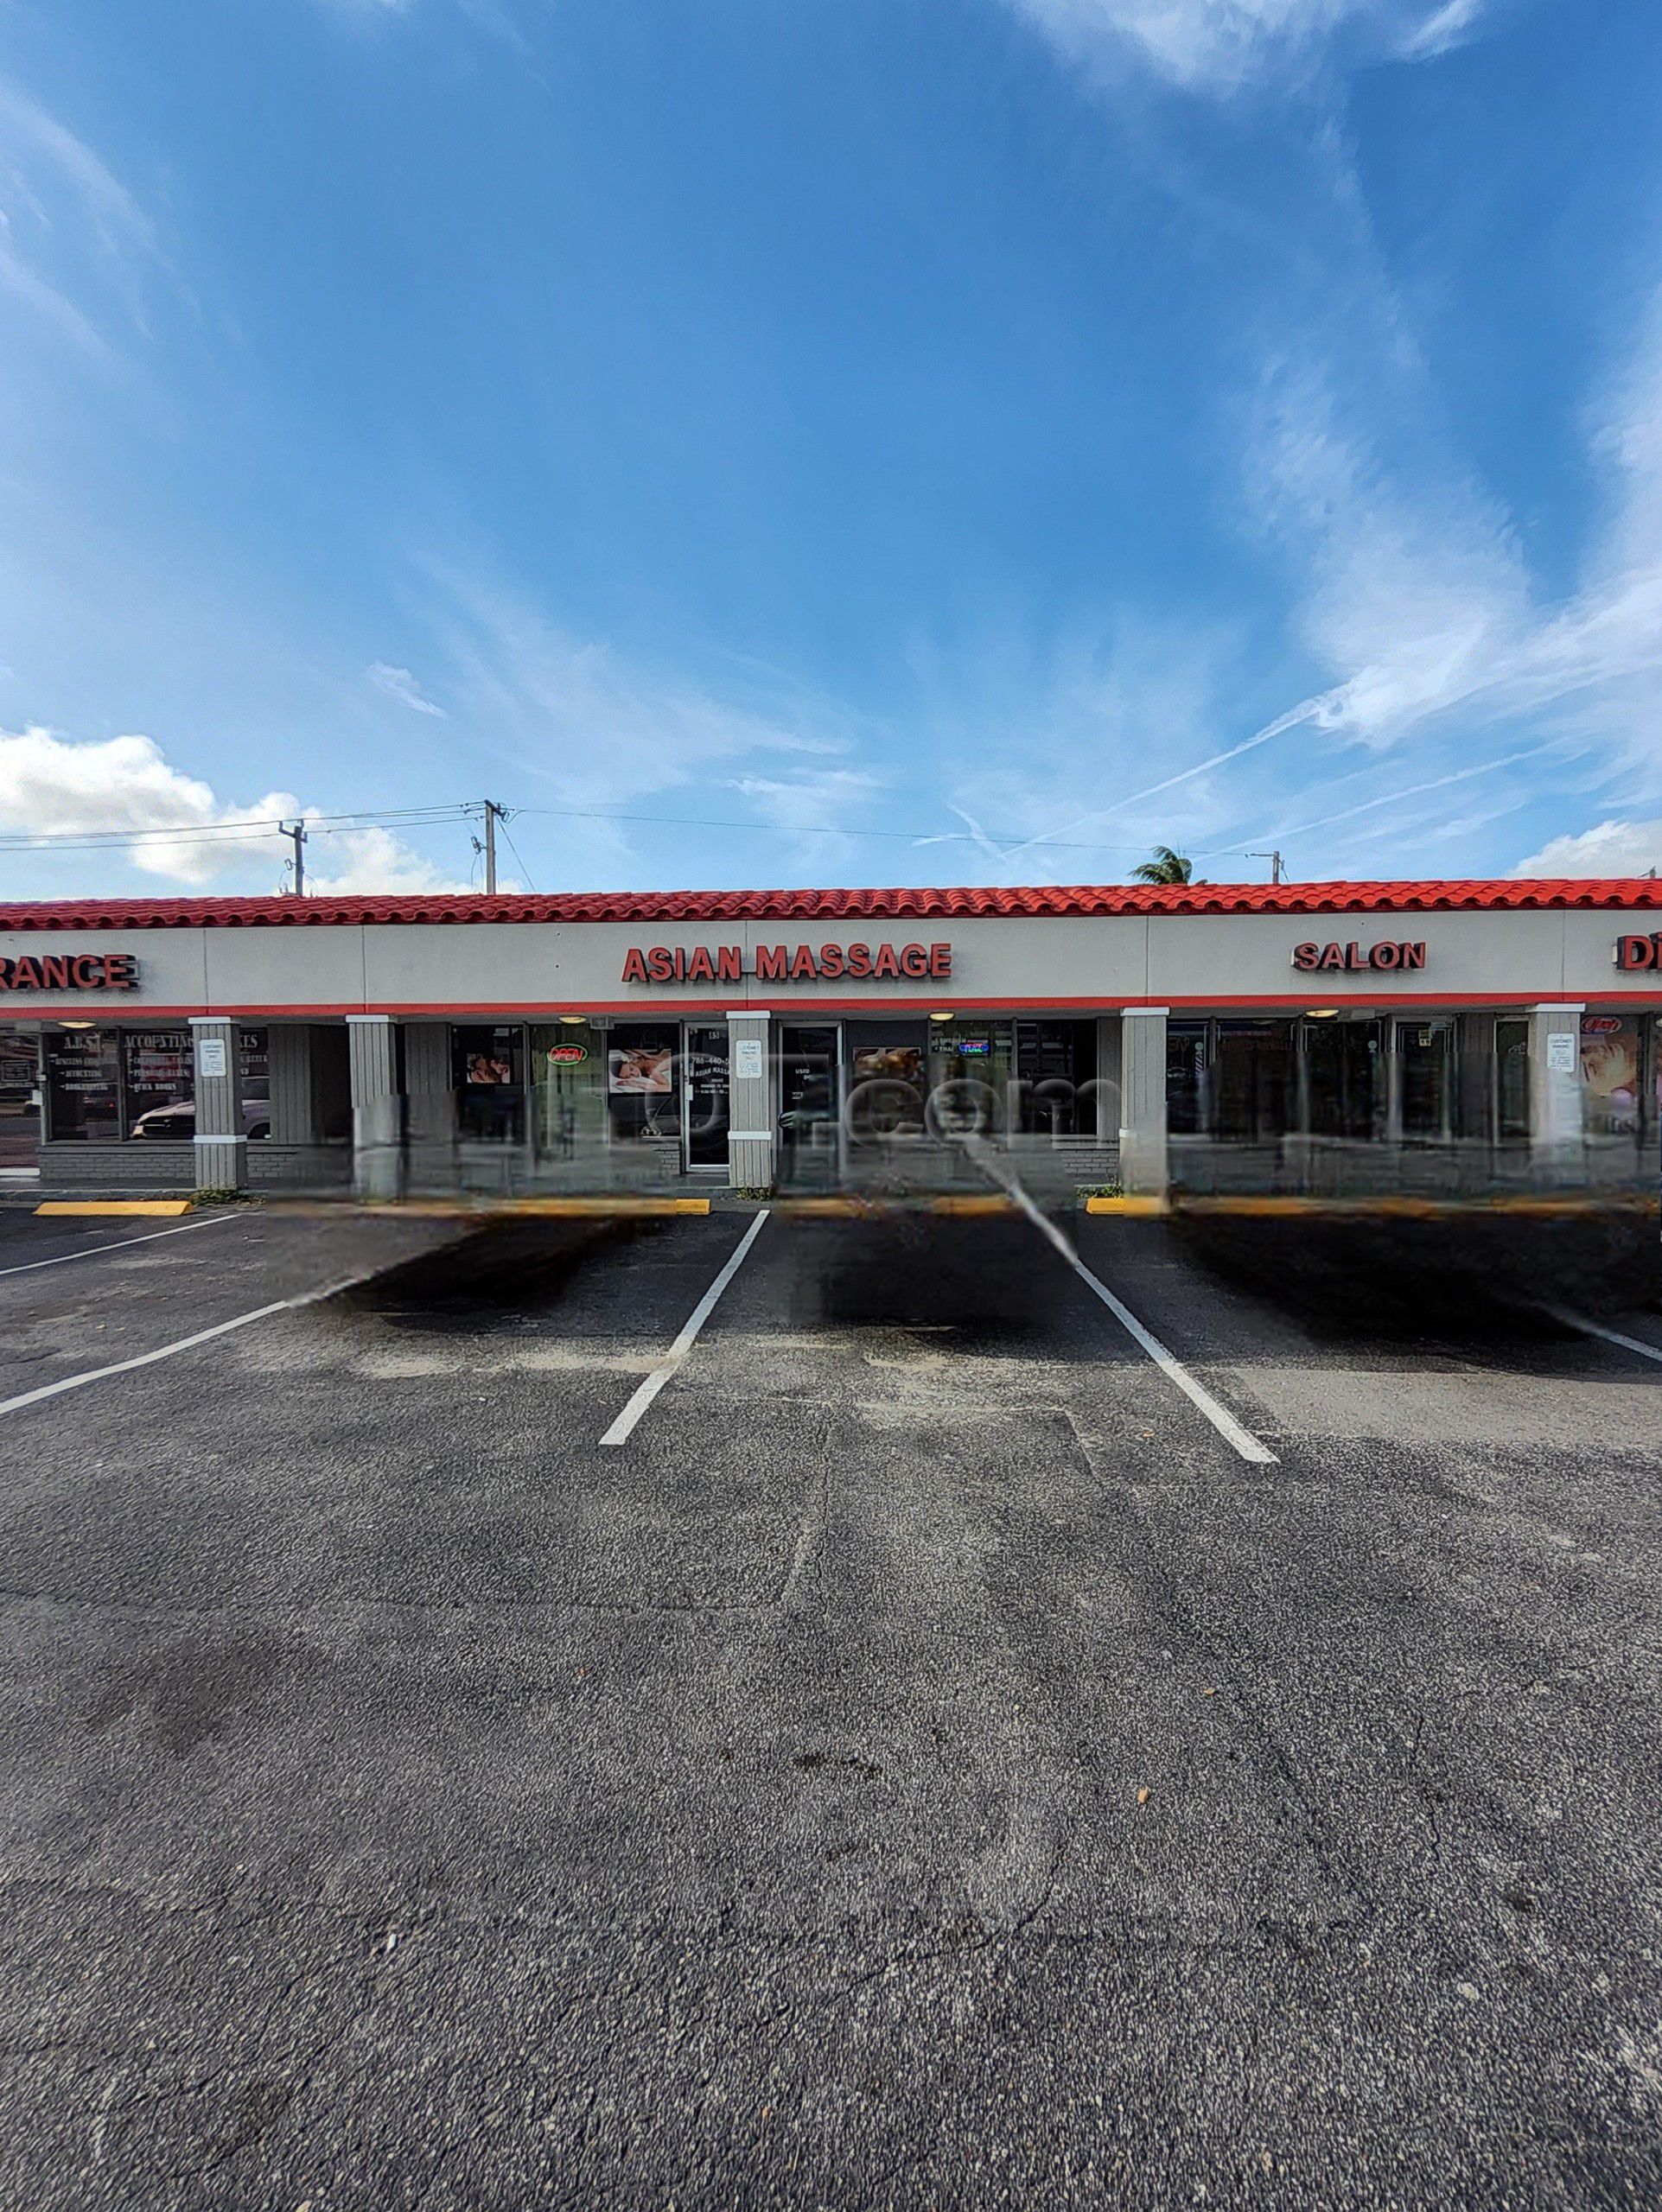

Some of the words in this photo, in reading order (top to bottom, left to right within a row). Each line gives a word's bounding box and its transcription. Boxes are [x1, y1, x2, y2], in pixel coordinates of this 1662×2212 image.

[621, 946, 742, 982] ASIAN
[755, 943, 952, 979] MASSAGE
[1294, 941, 1426, 969] SALON
[550, 1048, 583, 1061] OPEN
